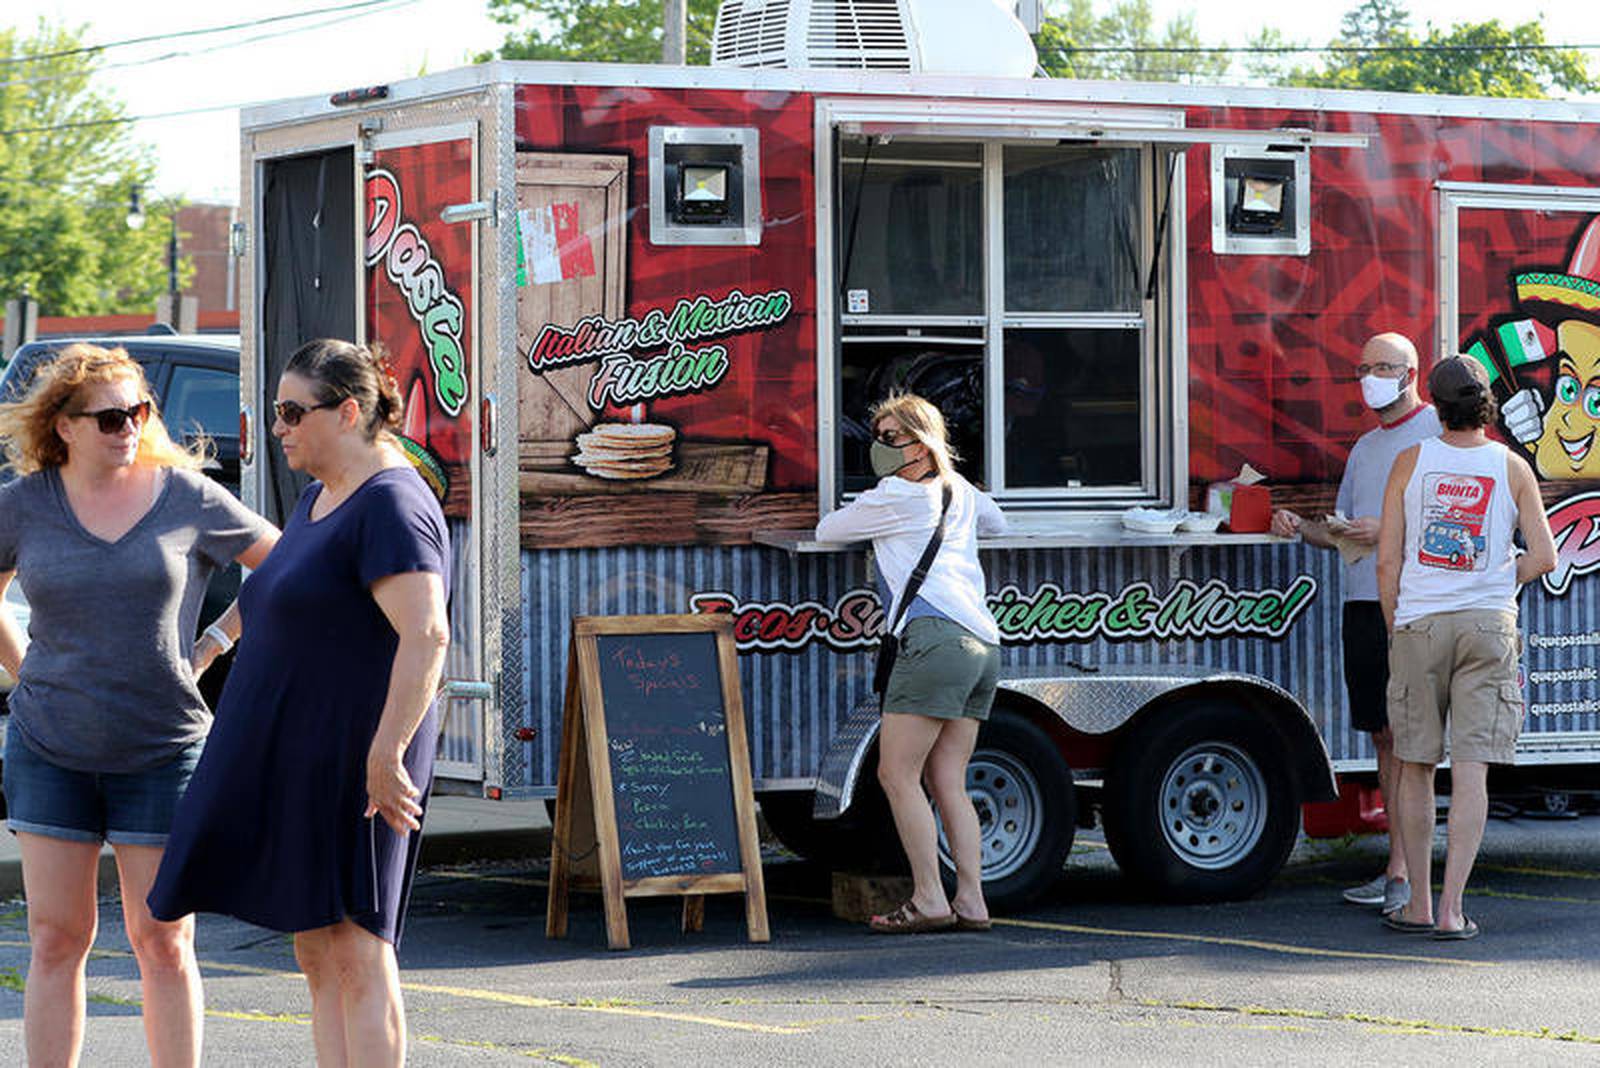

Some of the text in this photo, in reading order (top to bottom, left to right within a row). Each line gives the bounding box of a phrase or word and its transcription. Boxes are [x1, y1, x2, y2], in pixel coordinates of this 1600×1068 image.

[531, 292, 789, 367] Italian & Mexican
[591, 344, 727, 408] Fusion
[692, 581, 1312, 644] cos Saiches & More!
